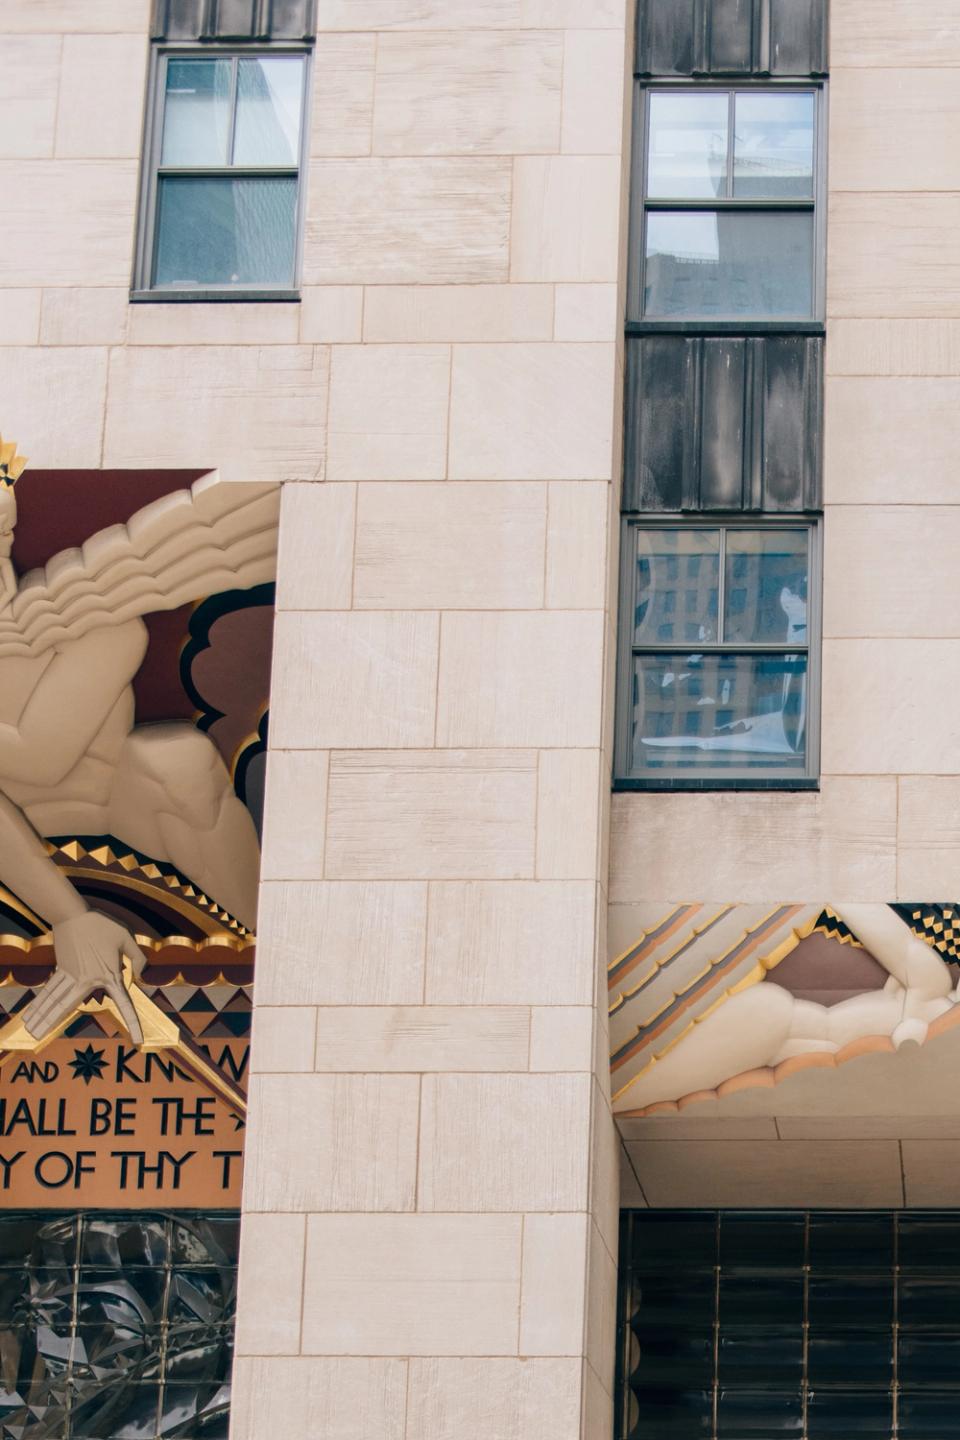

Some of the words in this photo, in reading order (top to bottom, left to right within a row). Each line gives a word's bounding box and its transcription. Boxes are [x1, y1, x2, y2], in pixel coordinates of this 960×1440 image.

[10, 1061, 59, 1083] AND
[90, 1098, 137, 1136] BE
[152, 1097, 216, 1136] THE
[34, 1151, 96, 1189] OF
[111, 1151, 198, 1189] THY
